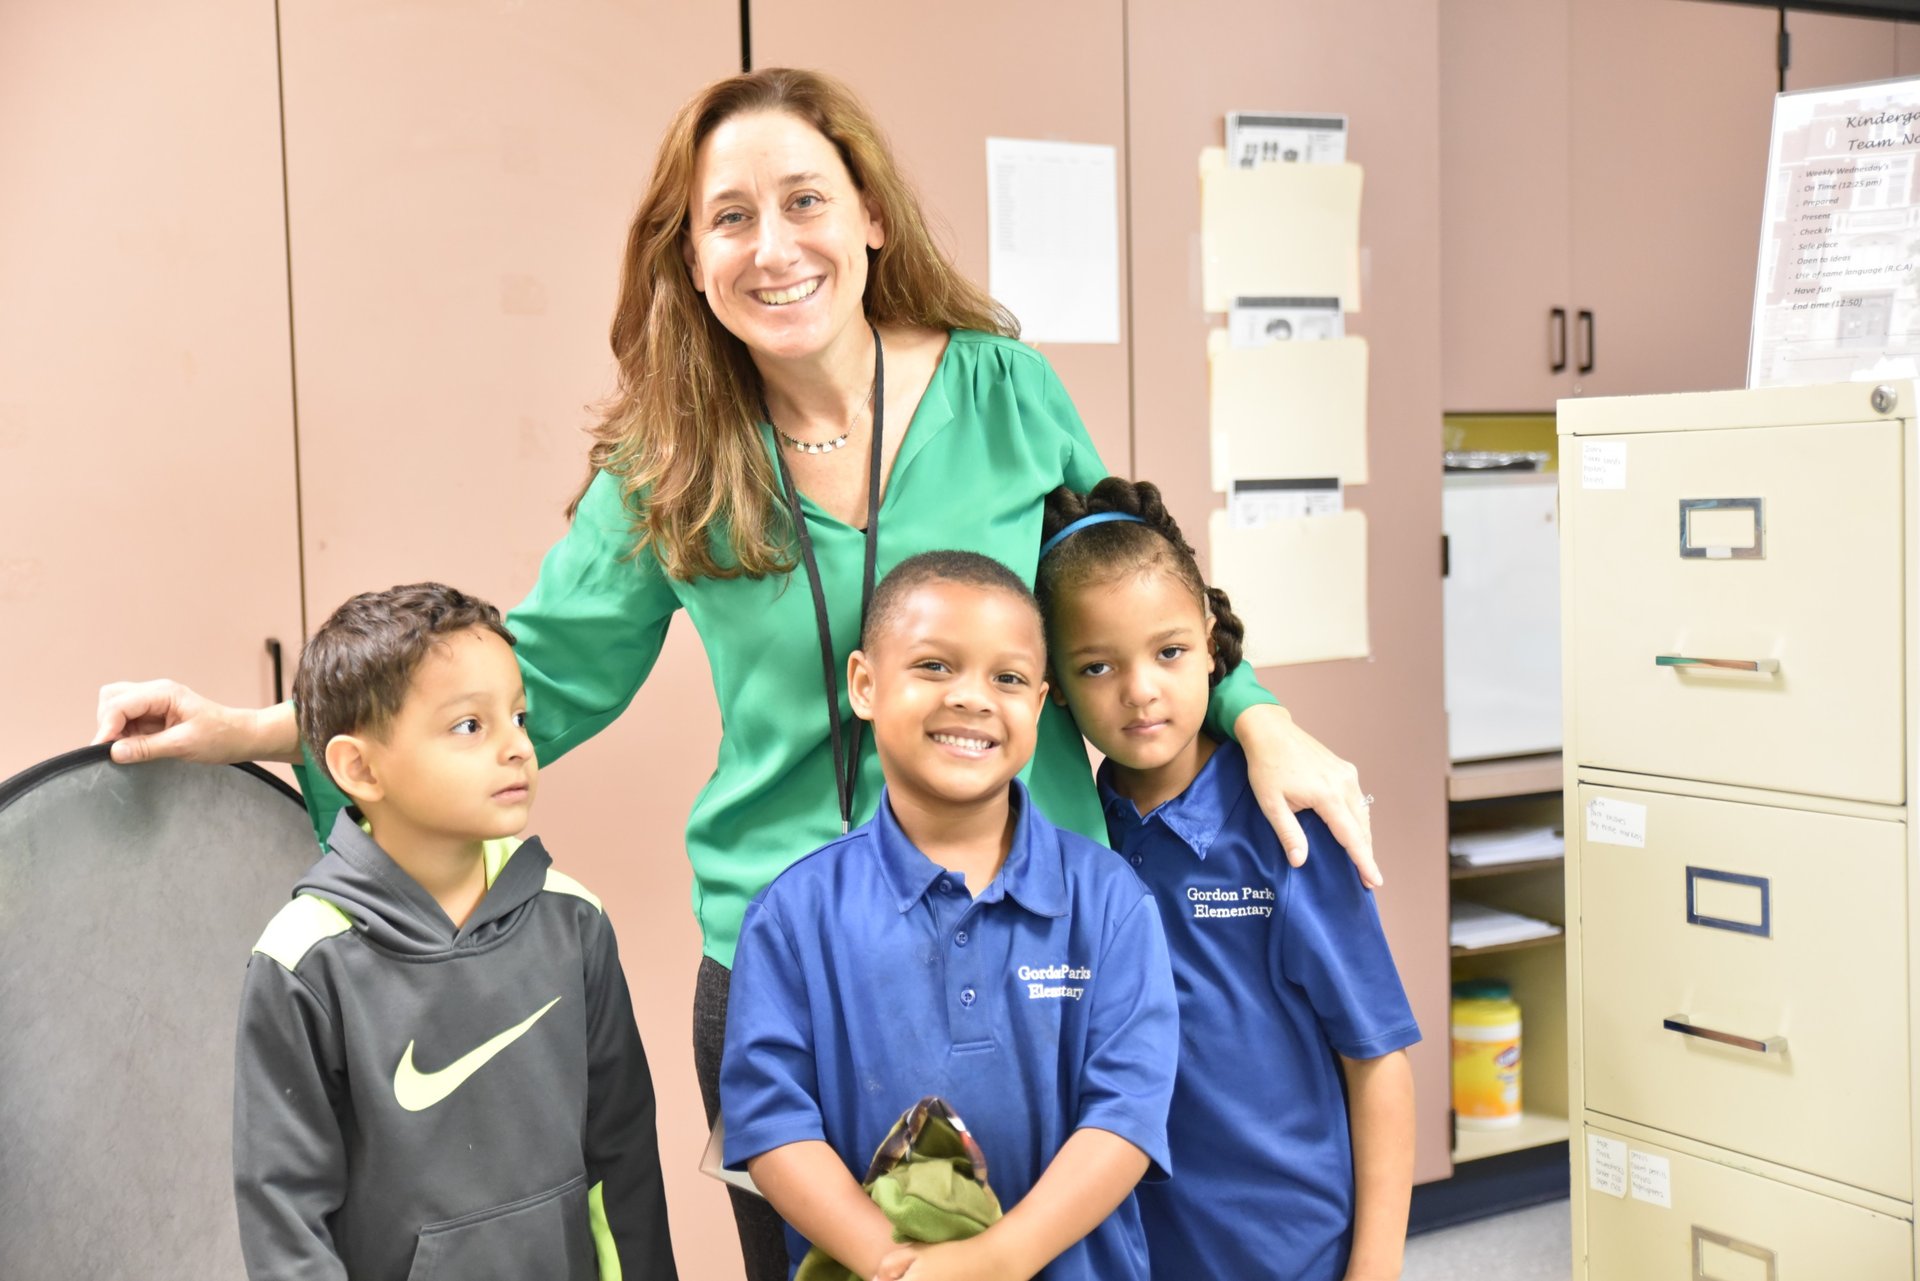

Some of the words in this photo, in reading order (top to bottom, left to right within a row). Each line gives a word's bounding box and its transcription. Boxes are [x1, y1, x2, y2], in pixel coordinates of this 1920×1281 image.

[1848, 138, 1896, 151] Team
[1805, 168, 1834, 178] Weekly
[1836, 164, 1889, 175] Wednesday's
[1804, 184, 1815, 193] On
[1817, 183, 1837, 192] Time
[1838, 181, 1864, 191] (12:25
[1865, 178, 1882, 188] pm)
[1802, 197, 1839, 207] Prepared
[1801, 213, 1831, 221] Present
[1799, 227, 1822, 236] Check
[1798, 242, 1816, 251] Safe
[1816, 241, 1839, 250] place
[1796, 257, 1818, 266] Open
[1819, 256, 1828, 264] to
[1795, 271, 1810, 280] Use
[1812, 270, 1821, 280] of
[1822, 270, 1843, 278] same
[1845, 265, 1883, 276] language
[1793, 286, 1816, 295] Have
[1817, 285, 1832, 296] fun
[1792, 302, 1808, 311] End
[1810, 301, 1830, 310] time
[1831, 297, 1863, 308] (12:50)
[1186, 887, 1239, 901] Gordon
[1193, 903, 1273, 918] Elementary
[1060, 963, 1092, 980] Parks
